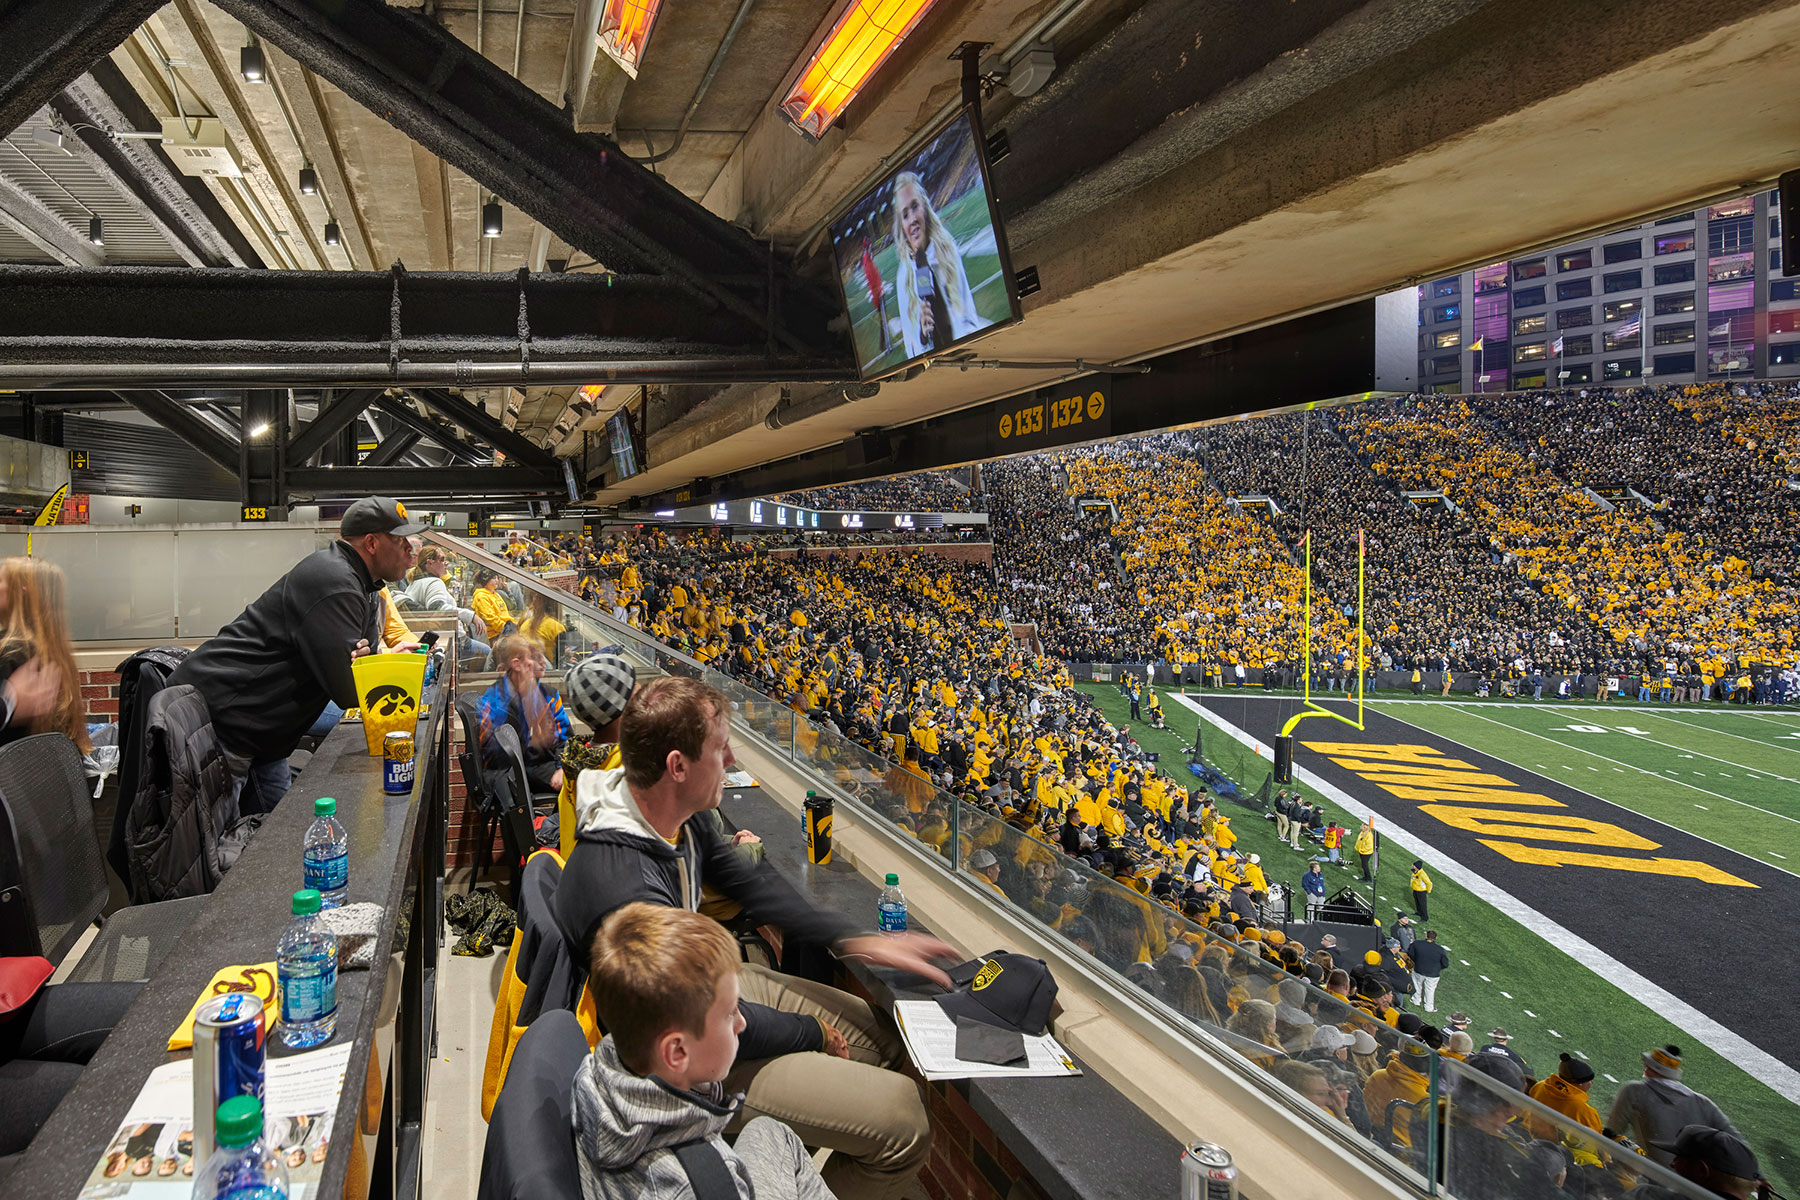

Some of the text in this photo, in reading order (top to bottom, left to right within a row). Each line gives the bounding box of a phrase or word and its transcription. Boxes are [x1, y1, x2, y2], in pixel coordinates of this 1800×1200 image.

[1015, 395, 1083, 436] 133 132
[243, 507, 267, 519] 133
[393, 763, 414, 773] BUD
[389, 772, 414, 782] LIGH
[1298, 741, 1761, 888] IOWA
